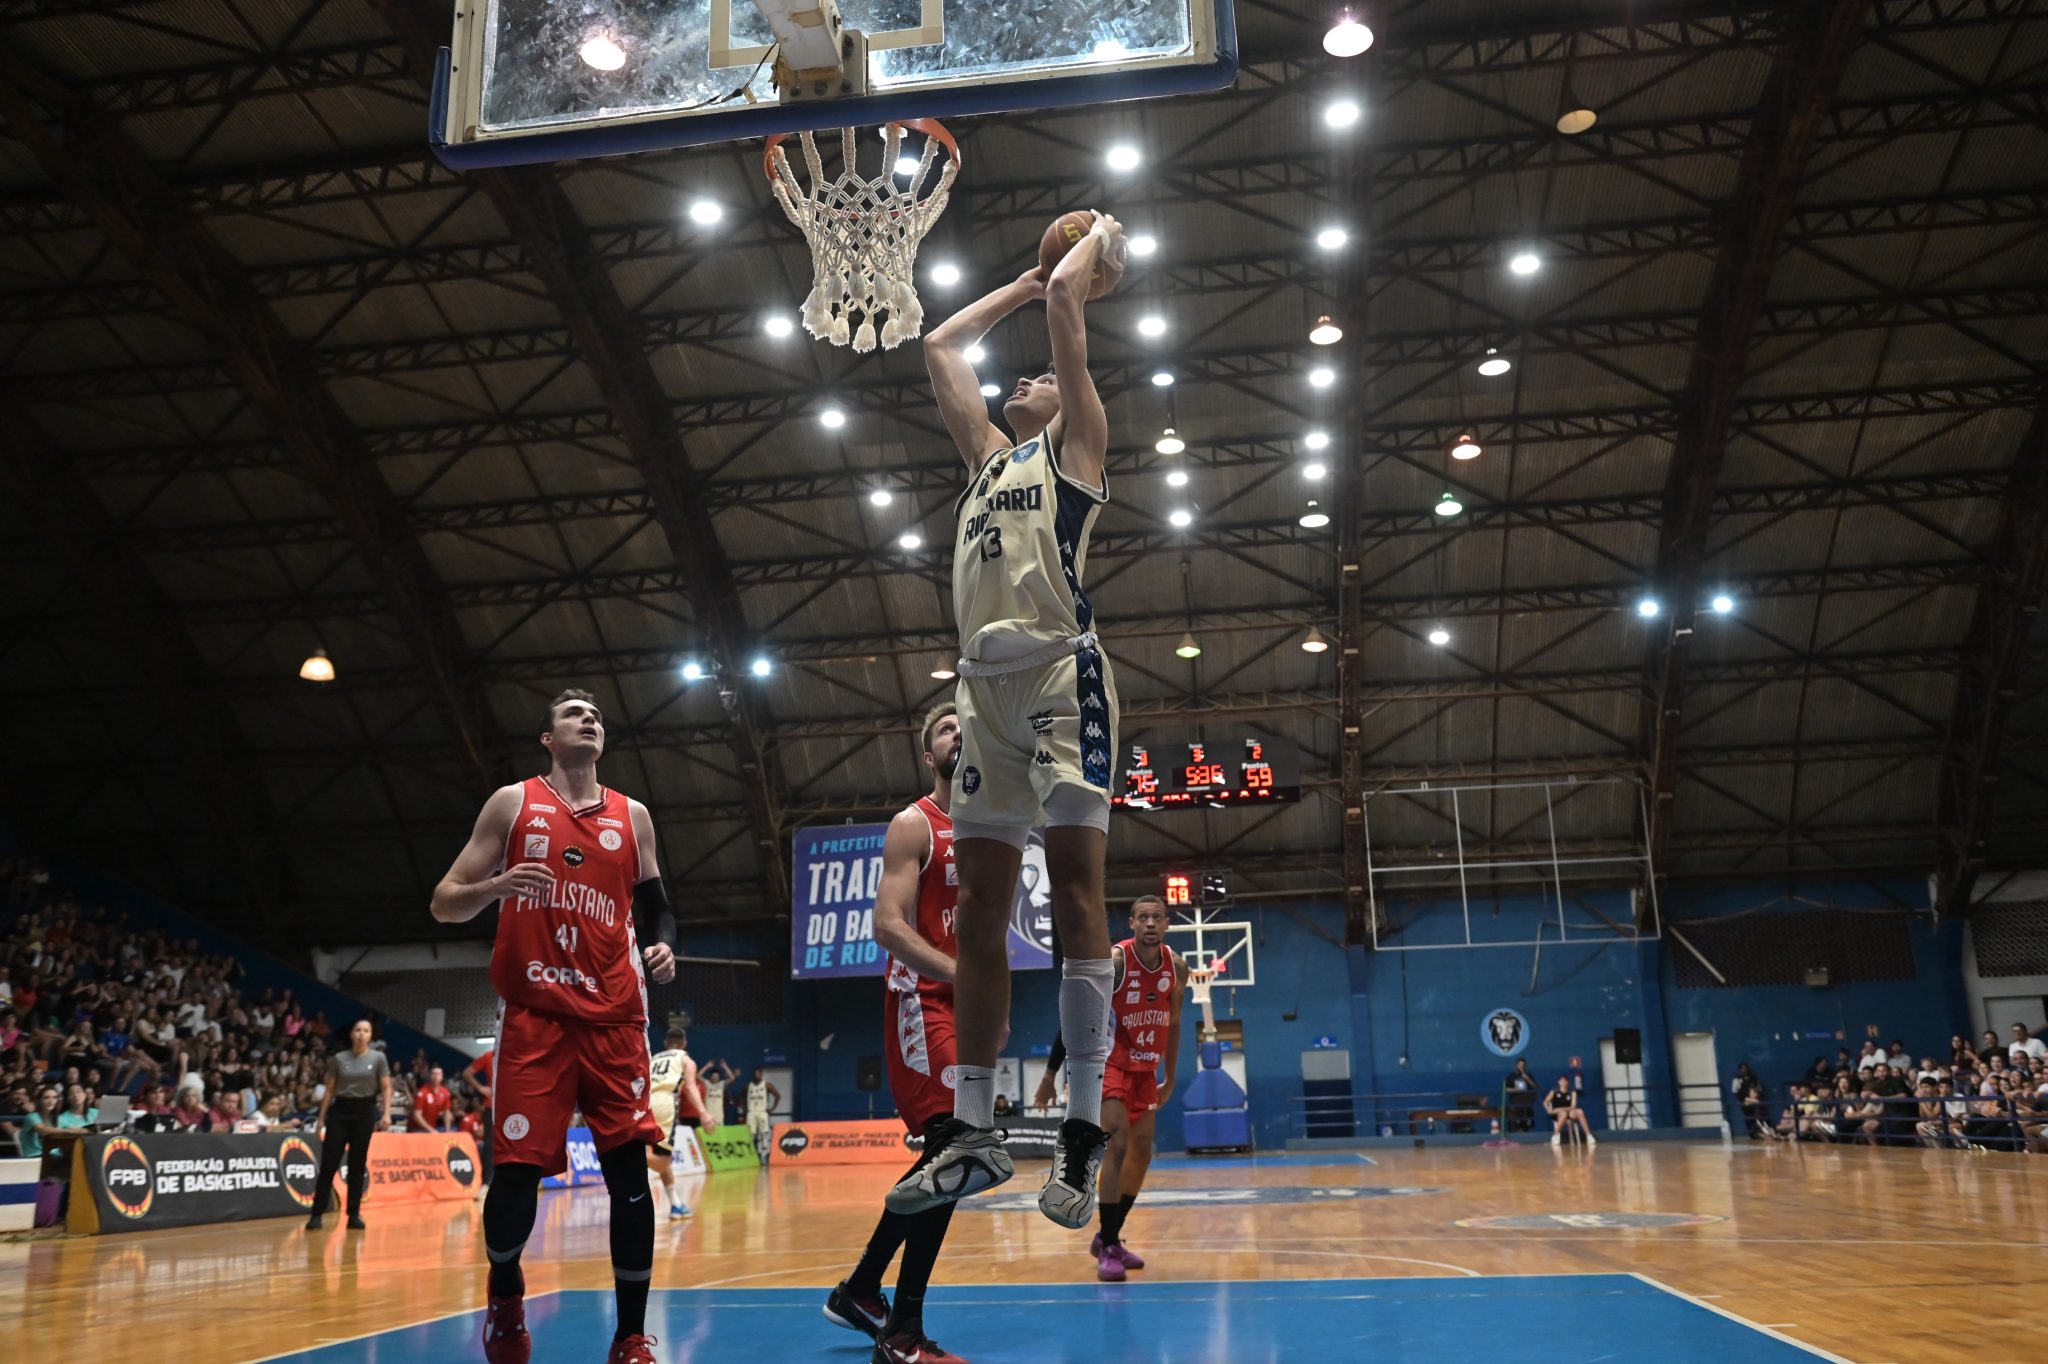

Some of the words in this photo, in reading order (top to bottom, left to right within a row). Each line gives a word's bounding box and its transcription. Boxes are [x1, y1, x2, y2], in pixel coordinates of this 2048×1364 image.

[985, 483, 1045, 513] ARO
[981, 526, 1002, 563] 13
[1246, 767, 1273, 787] 59
[564, 852, 582, 862] FPB
[810, 842, 818, 855] A
[807, 912, 838, 945] DO
[555, 923, 579, 953] 41
[805, 945, 835, 969] DE
[840, 941, 878, 965] RIO
[1136, 1030, 1155, 1046] 44
[781, 1137, 807, 1148] FPB
[811, 1140, 824, 1149] DE
[828, 1139, 897, 1148] BASKETBALL
[156, 1157, 224, 1175] FEDERAÇÃO
[228, 1157, 278, 1171] PAULISTA
[285, 1164, 316, 1180] FPB
[109, 1169, 147, 1186] FPB
[156, 1176, 180, 1194] DE
[184, 1172, 280, 1193] BASKETBALL
[373, 1171, 386, 1184] DE
